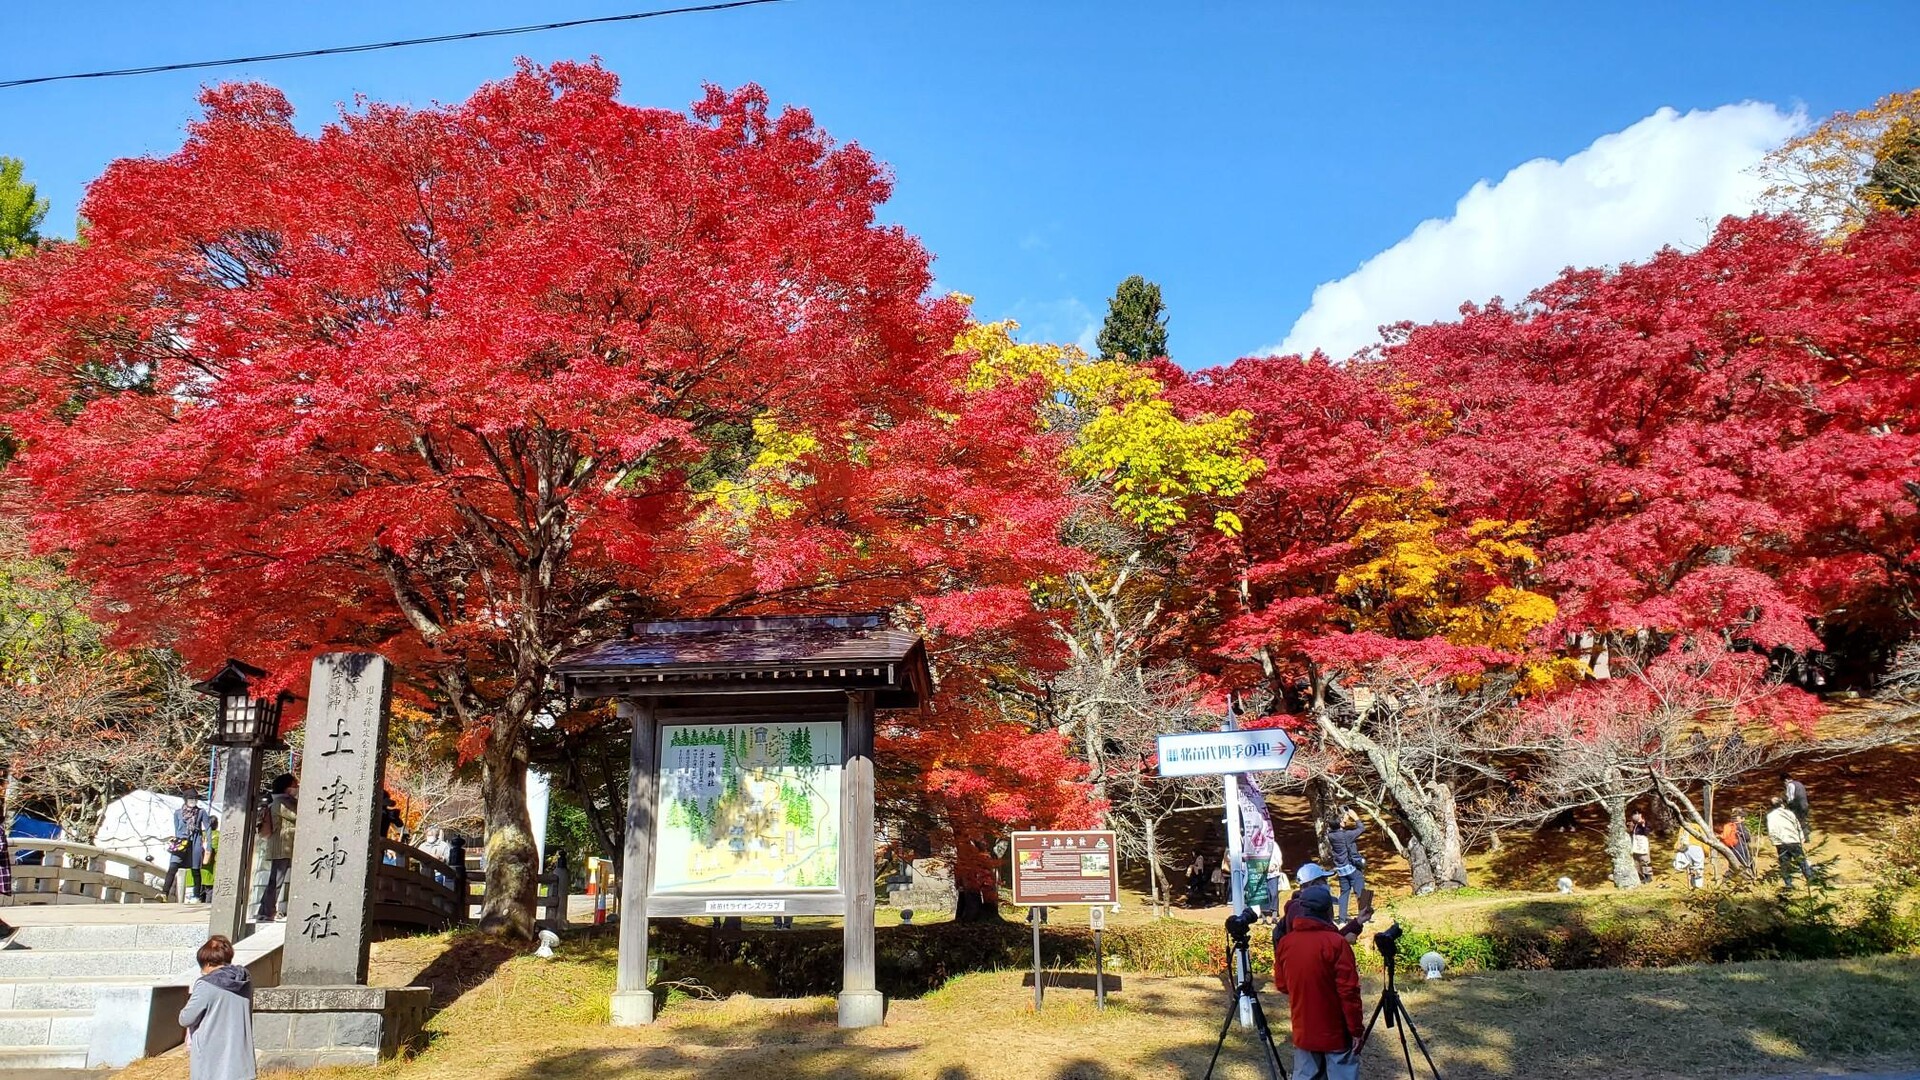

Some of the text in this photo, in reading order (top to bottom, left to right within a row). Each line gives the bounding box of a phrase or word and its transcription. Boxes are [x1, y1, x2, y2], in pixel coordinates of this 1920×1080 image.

[1180, 742, 1271, 762] 猪苗代四季の里
[707, 751, 717, 787] 土津神社
[302, 718, 354, 943] 土津神社
[1041, 837, 1087, 847] 土津神社
[710, 901, 780, 910] 猪苗代ライオンズクラブ
